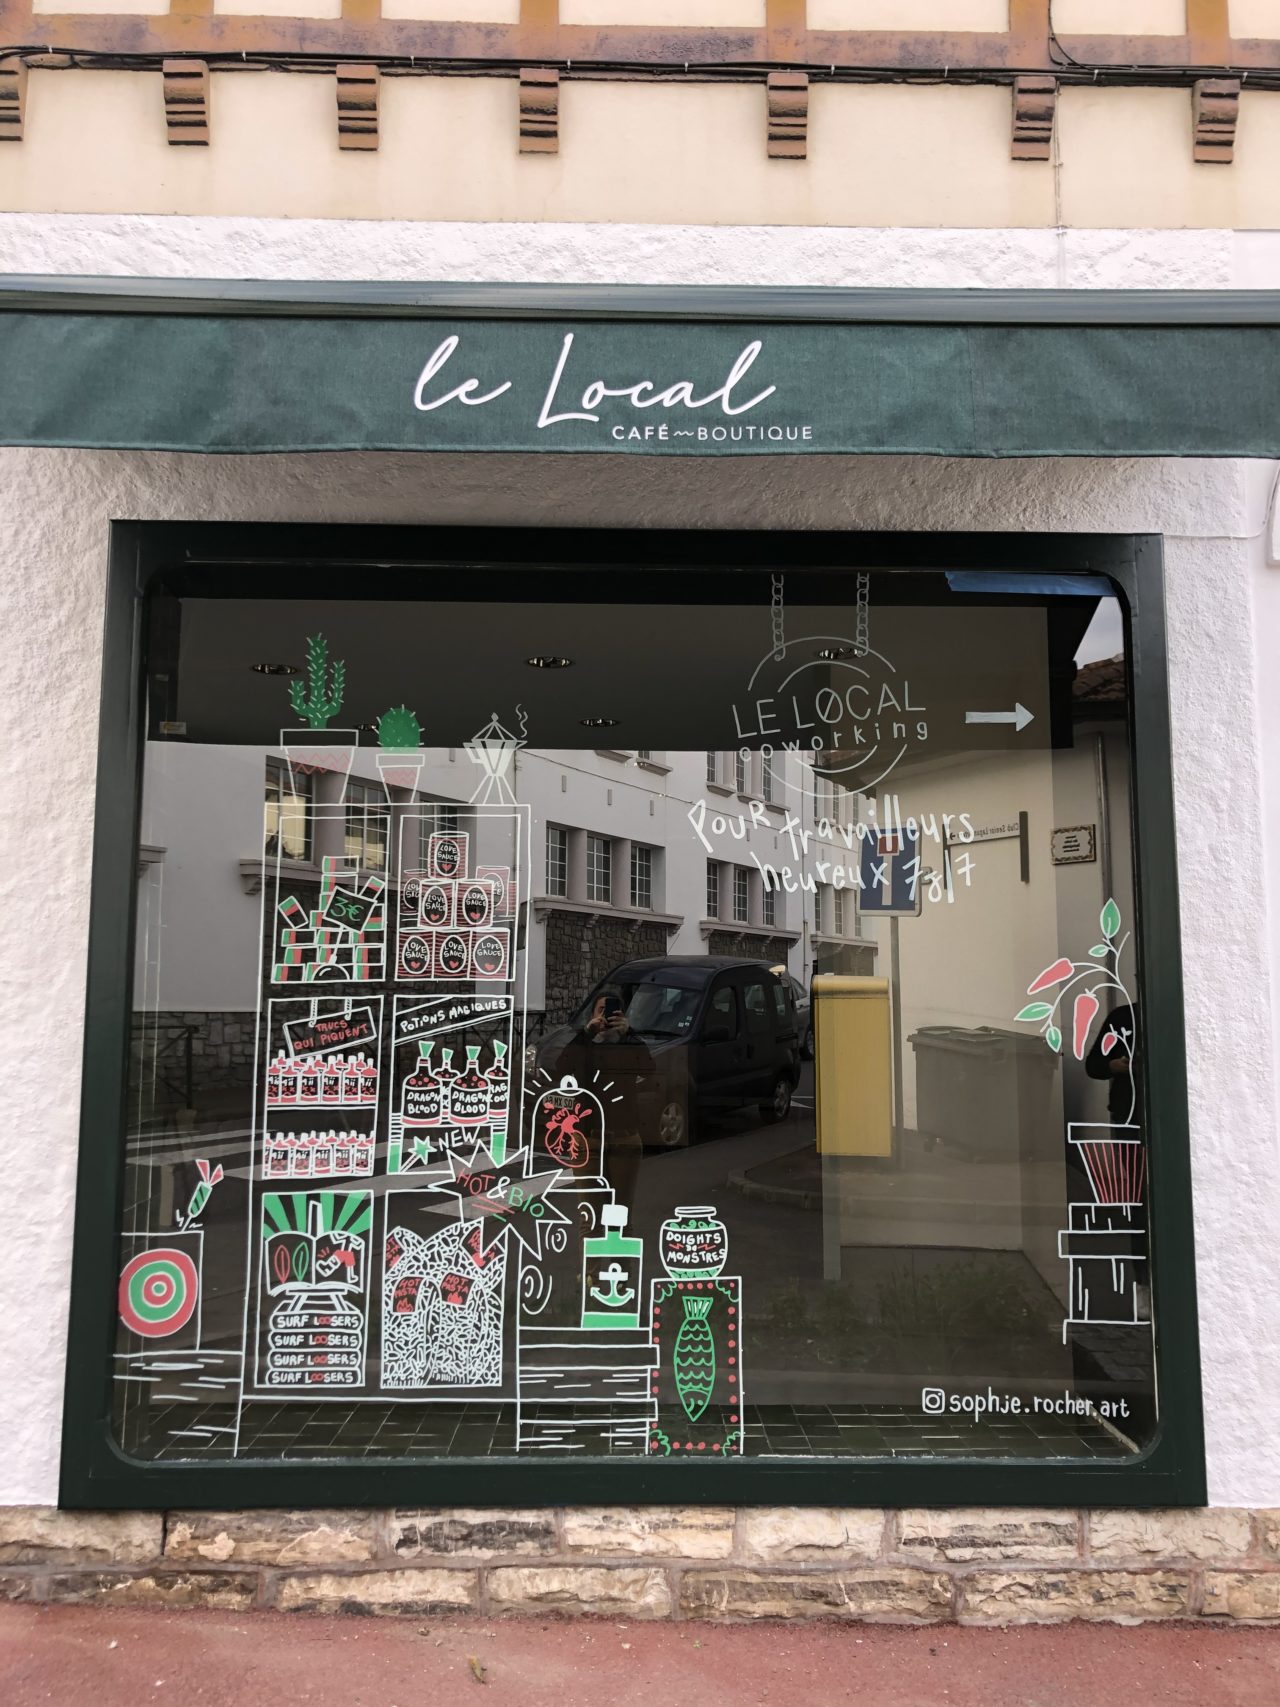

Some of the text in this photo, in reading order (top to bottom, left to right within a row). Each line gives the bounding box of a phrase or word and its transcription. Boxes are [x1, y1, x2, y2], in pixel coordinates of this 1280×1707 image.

[414, 333, 776, 428] le Local
[732, 699, 781, 738] LE
[779, 794, 976, 861] travailleurs
[750, 851, 889, 893] heureux
[400, 1000, 507, 1032] POTIONS MAGIQUES
[315, 1019, 348, 1032] TRUCS
[293, 1023, 369, 1050] QUI PIQUENT
[406, 1091, 440, 1102] DRAGON
[452, 1091, 488, 1103] DRAGON
[407, 1103, 438, 1114] BLOOD
[453, 1102, 486, 1114] BLOOD
[438, 1126, 480, 1151] NEW
[456, 1167, 545, 1217] HOT & BIO
[666, 1231, 721, 1245] DOIGHTS
[667, 1248, 726, 1264] MONSTRES
[277, 1315, 359, 1328] SURF LOOSERS
[274, 1333, 358, 1347] SURF LOOSERS
[273, 1353, 356, 1366] SURF LOOSERS
[272, 1371, 353, 1384] SURF LOOSERS
